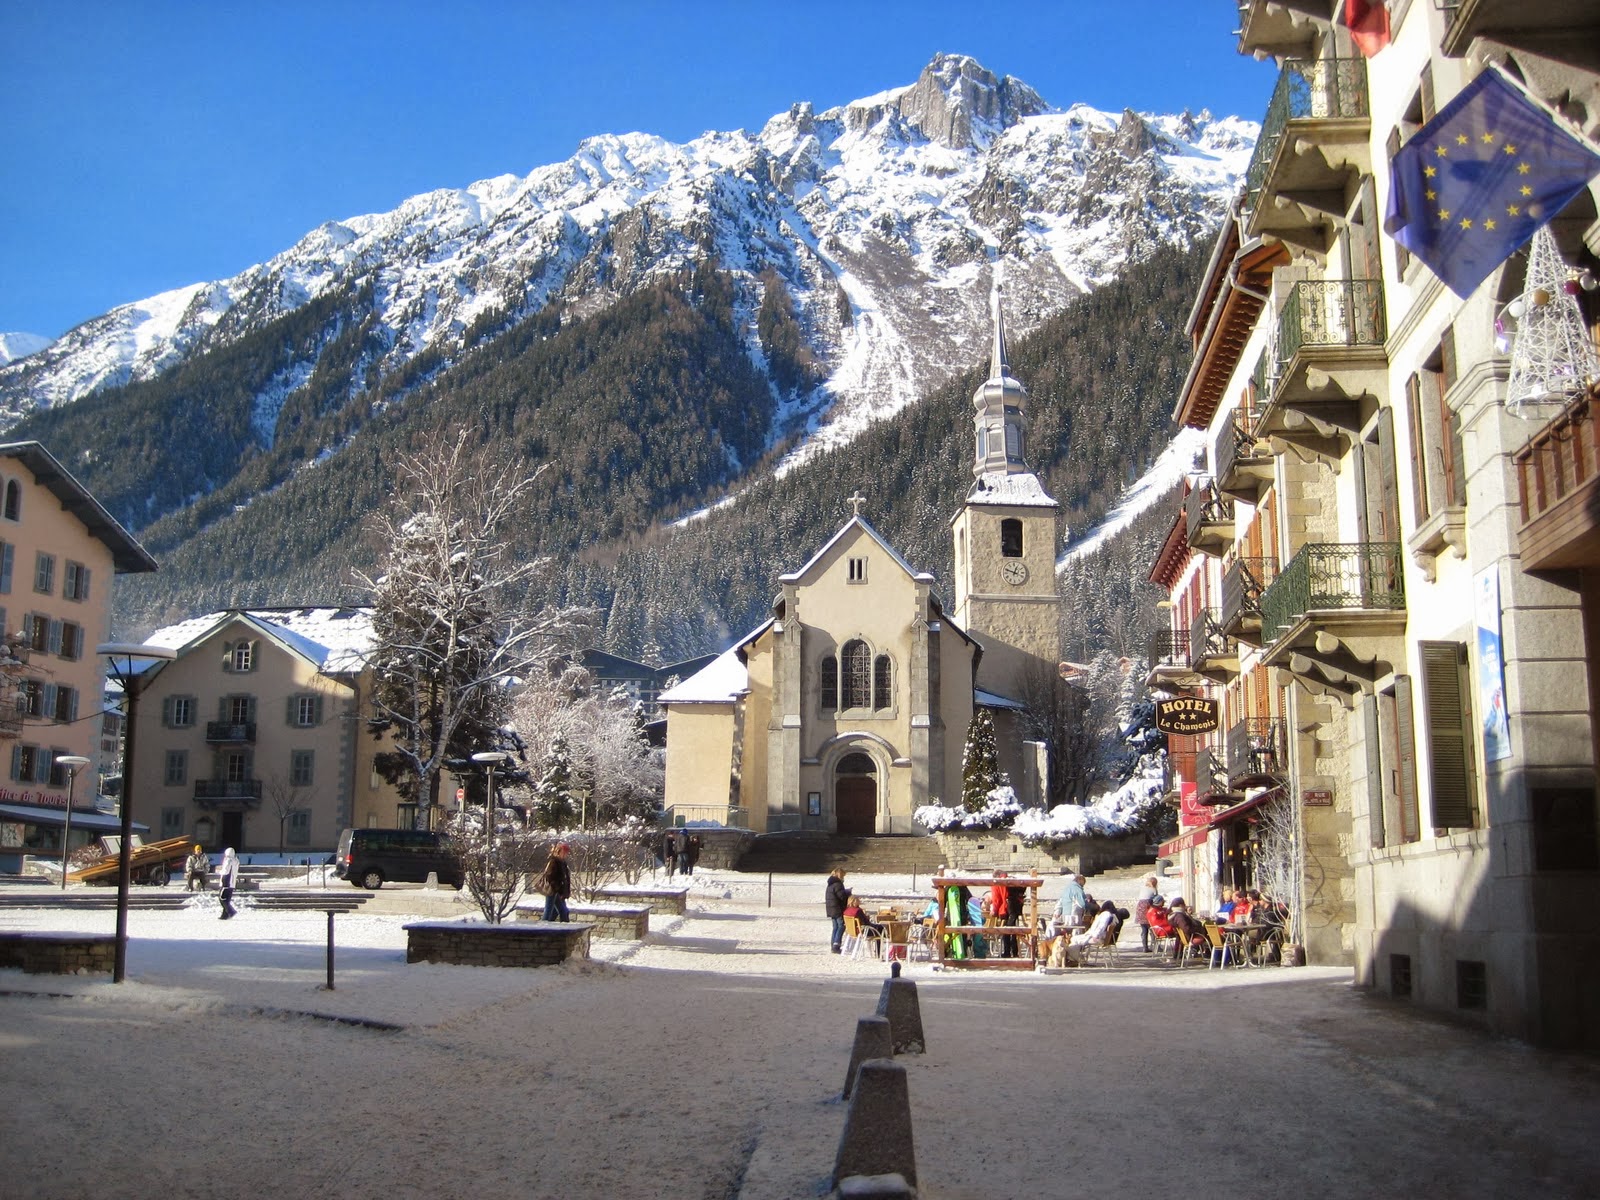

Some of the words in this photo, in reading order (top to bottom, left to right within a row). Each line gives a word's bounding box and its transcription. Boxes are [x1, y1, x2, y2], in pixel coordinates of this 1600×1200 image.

[1161, 699, 1212, 714] HOTEL
[1160, 718, 1171, 728] Le
[1174, 719, 1216, 731] Chamonix
[36, 792, 78, 807] Tourise
